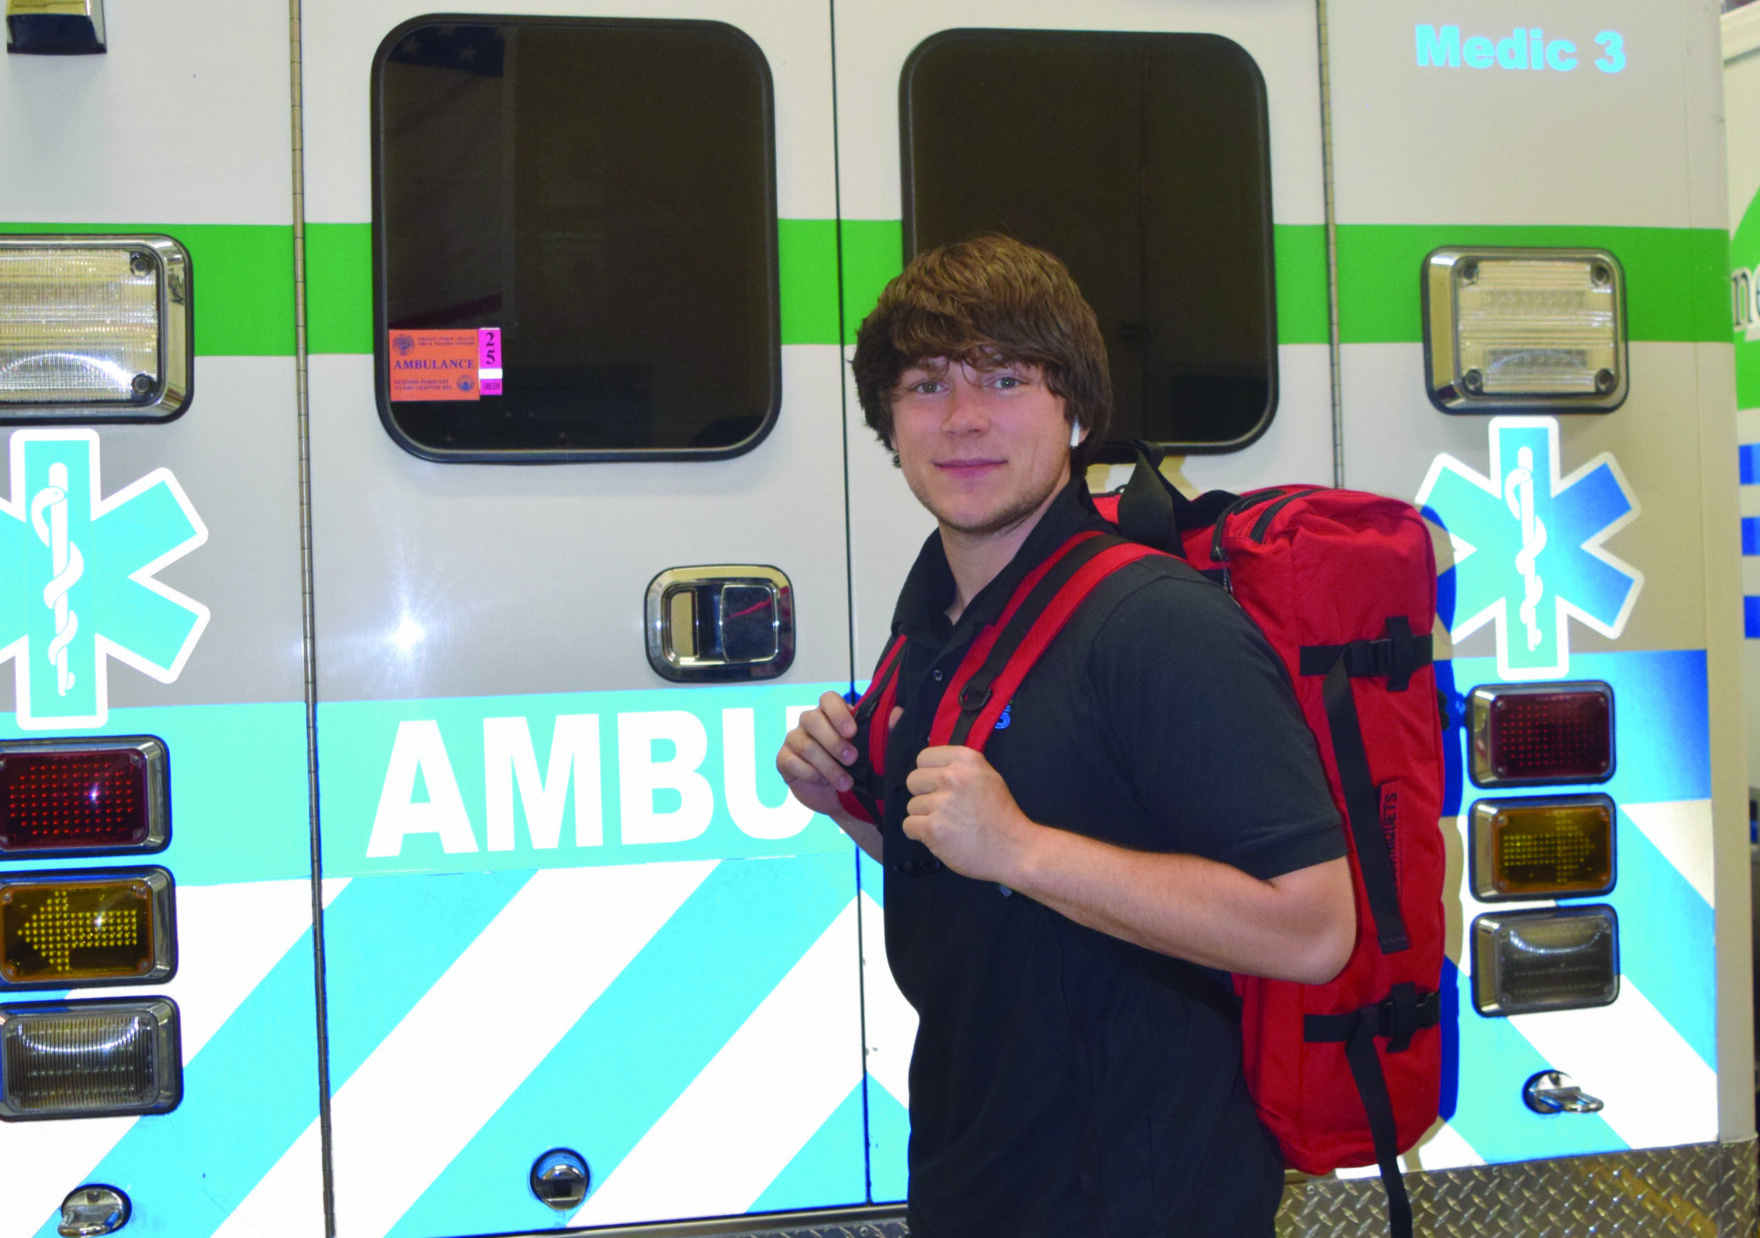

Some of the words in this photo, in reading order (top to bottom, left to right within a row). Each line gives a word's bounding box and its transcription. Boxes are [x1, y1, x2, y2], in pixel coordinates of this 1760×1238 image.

[1415, 24, 1579, 71] Medic
[1594, 30, 1627, 73] 3
[393, 359, 475, 370] AMBULANCE
[365, 707, 846, 858] AMBU
